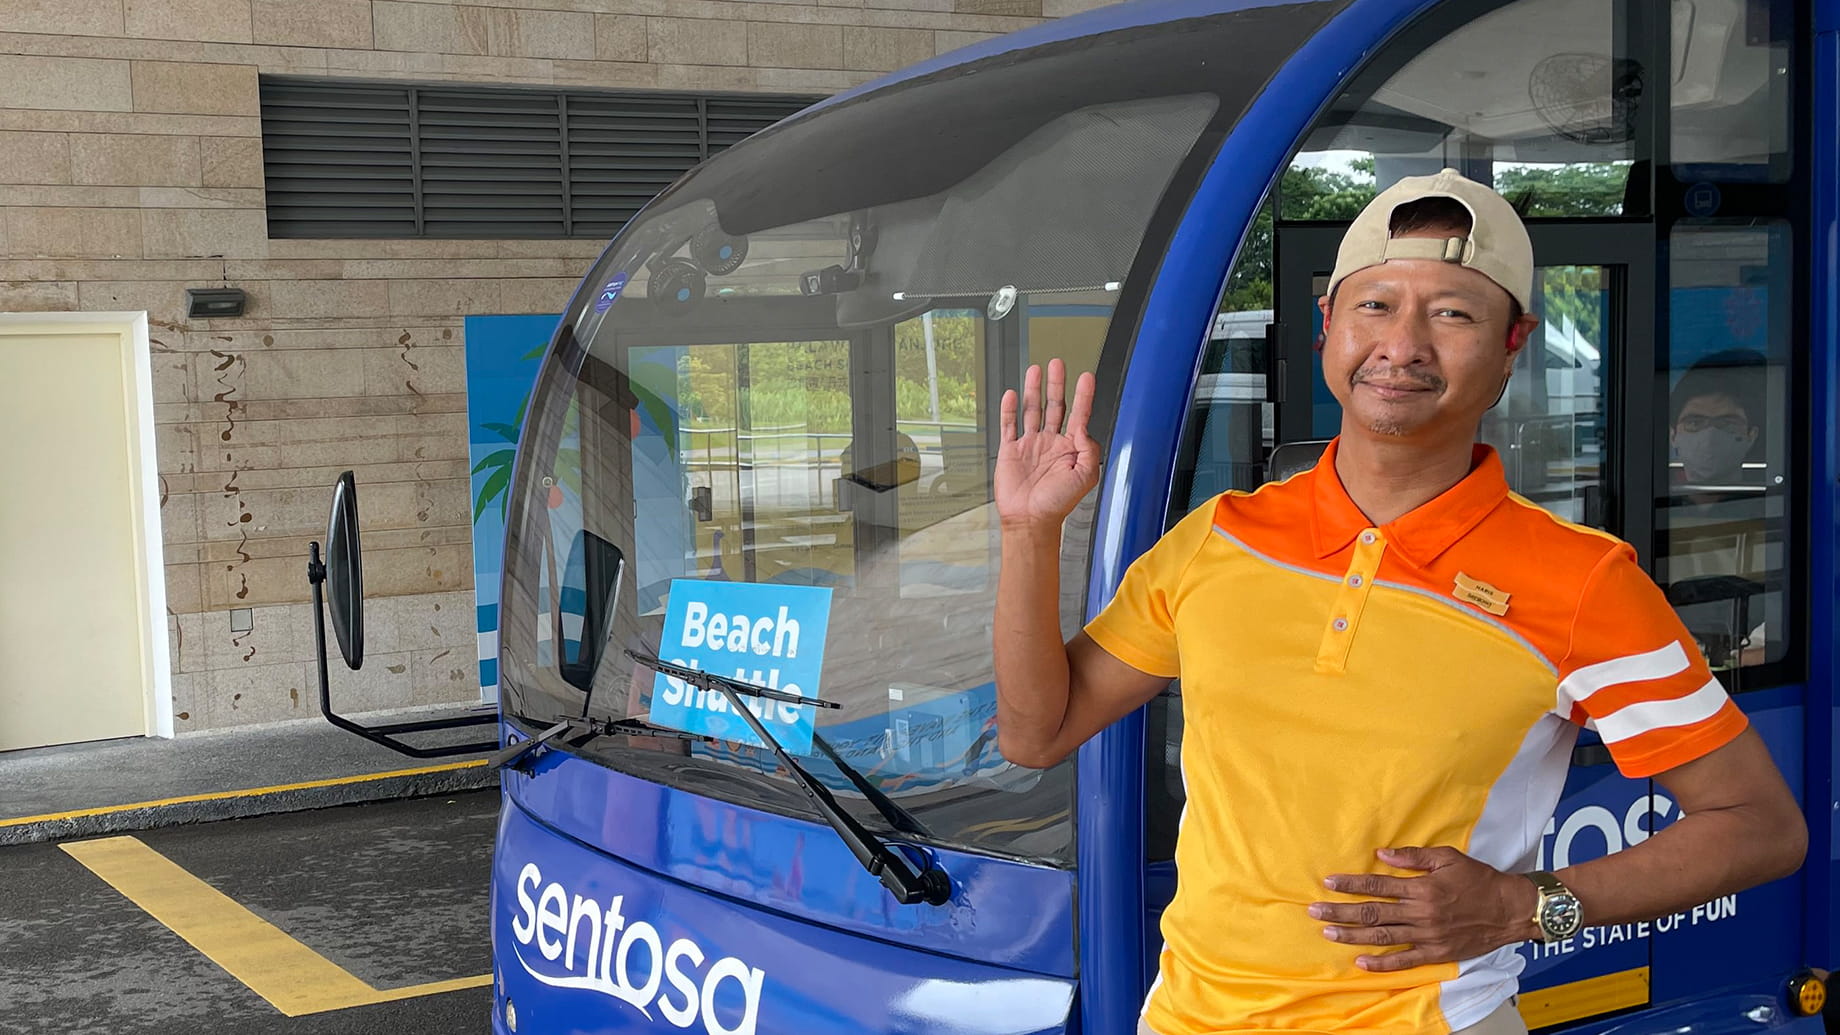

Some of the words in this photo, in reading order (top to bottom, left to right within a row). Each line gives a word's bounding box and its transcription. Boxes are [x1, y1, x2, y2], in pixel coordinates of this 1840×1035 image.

[681, 601, 800, 658] Beach
[662, 658, 803, 724] Shuttle
[512, 862, 765, 1035] sentosa
[1529, 938, 1575, 961] THE
[1582, 921, 1650, 949] STATE
[1656, 912, 1686, 933] OF
[1692, 894, 1737, 925] FUN
